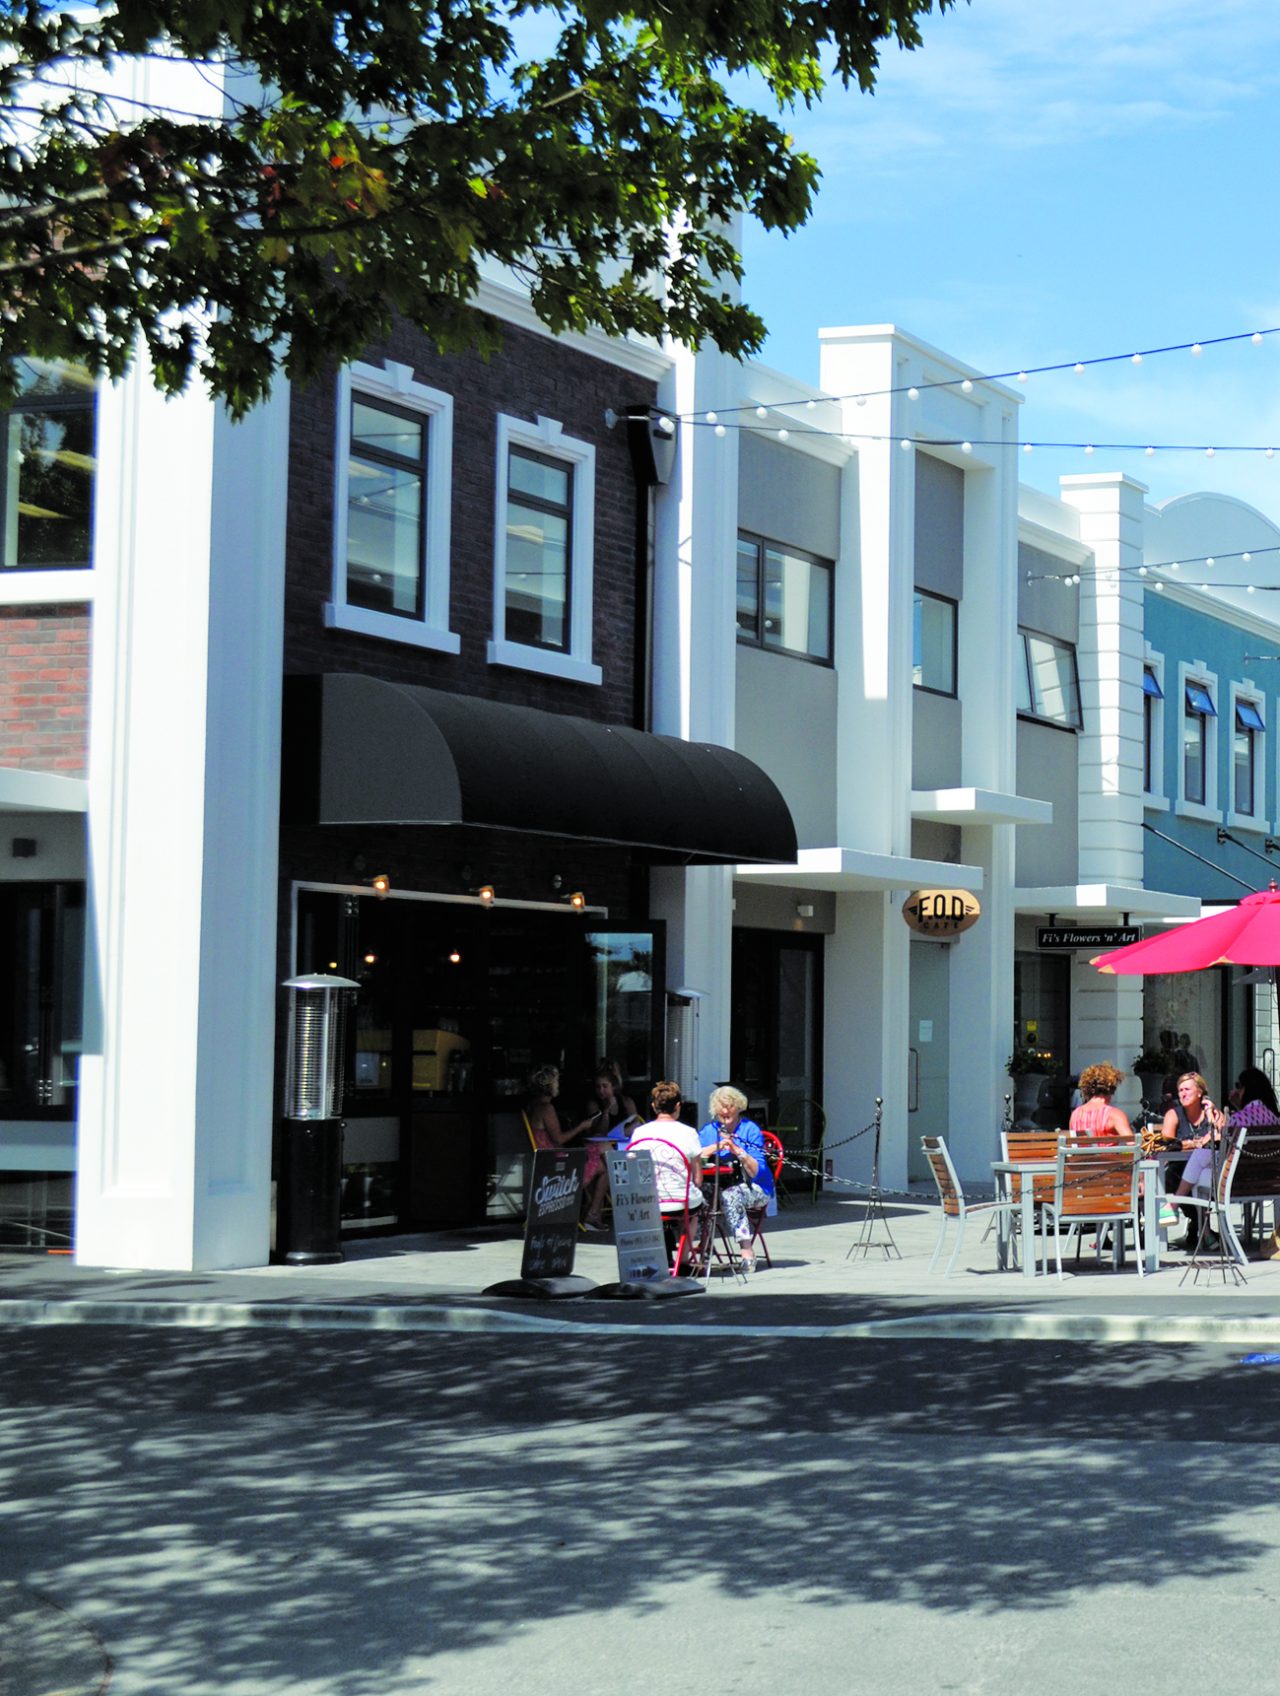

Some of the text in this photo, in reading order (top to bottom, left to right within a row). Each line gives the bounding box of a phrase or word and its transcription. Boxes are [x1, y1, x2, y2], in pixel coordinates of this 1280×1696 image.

[1042, 933, 1060, 943] Fi's
[1063, 933, 1101, 943] Flowers
[1119, 932, 1136, 942] Art
[535, 1168, 580, 1205] Switch
[616, 1193, 629, 1207] Fi's
[640, 1209, 650, 1221] Art
